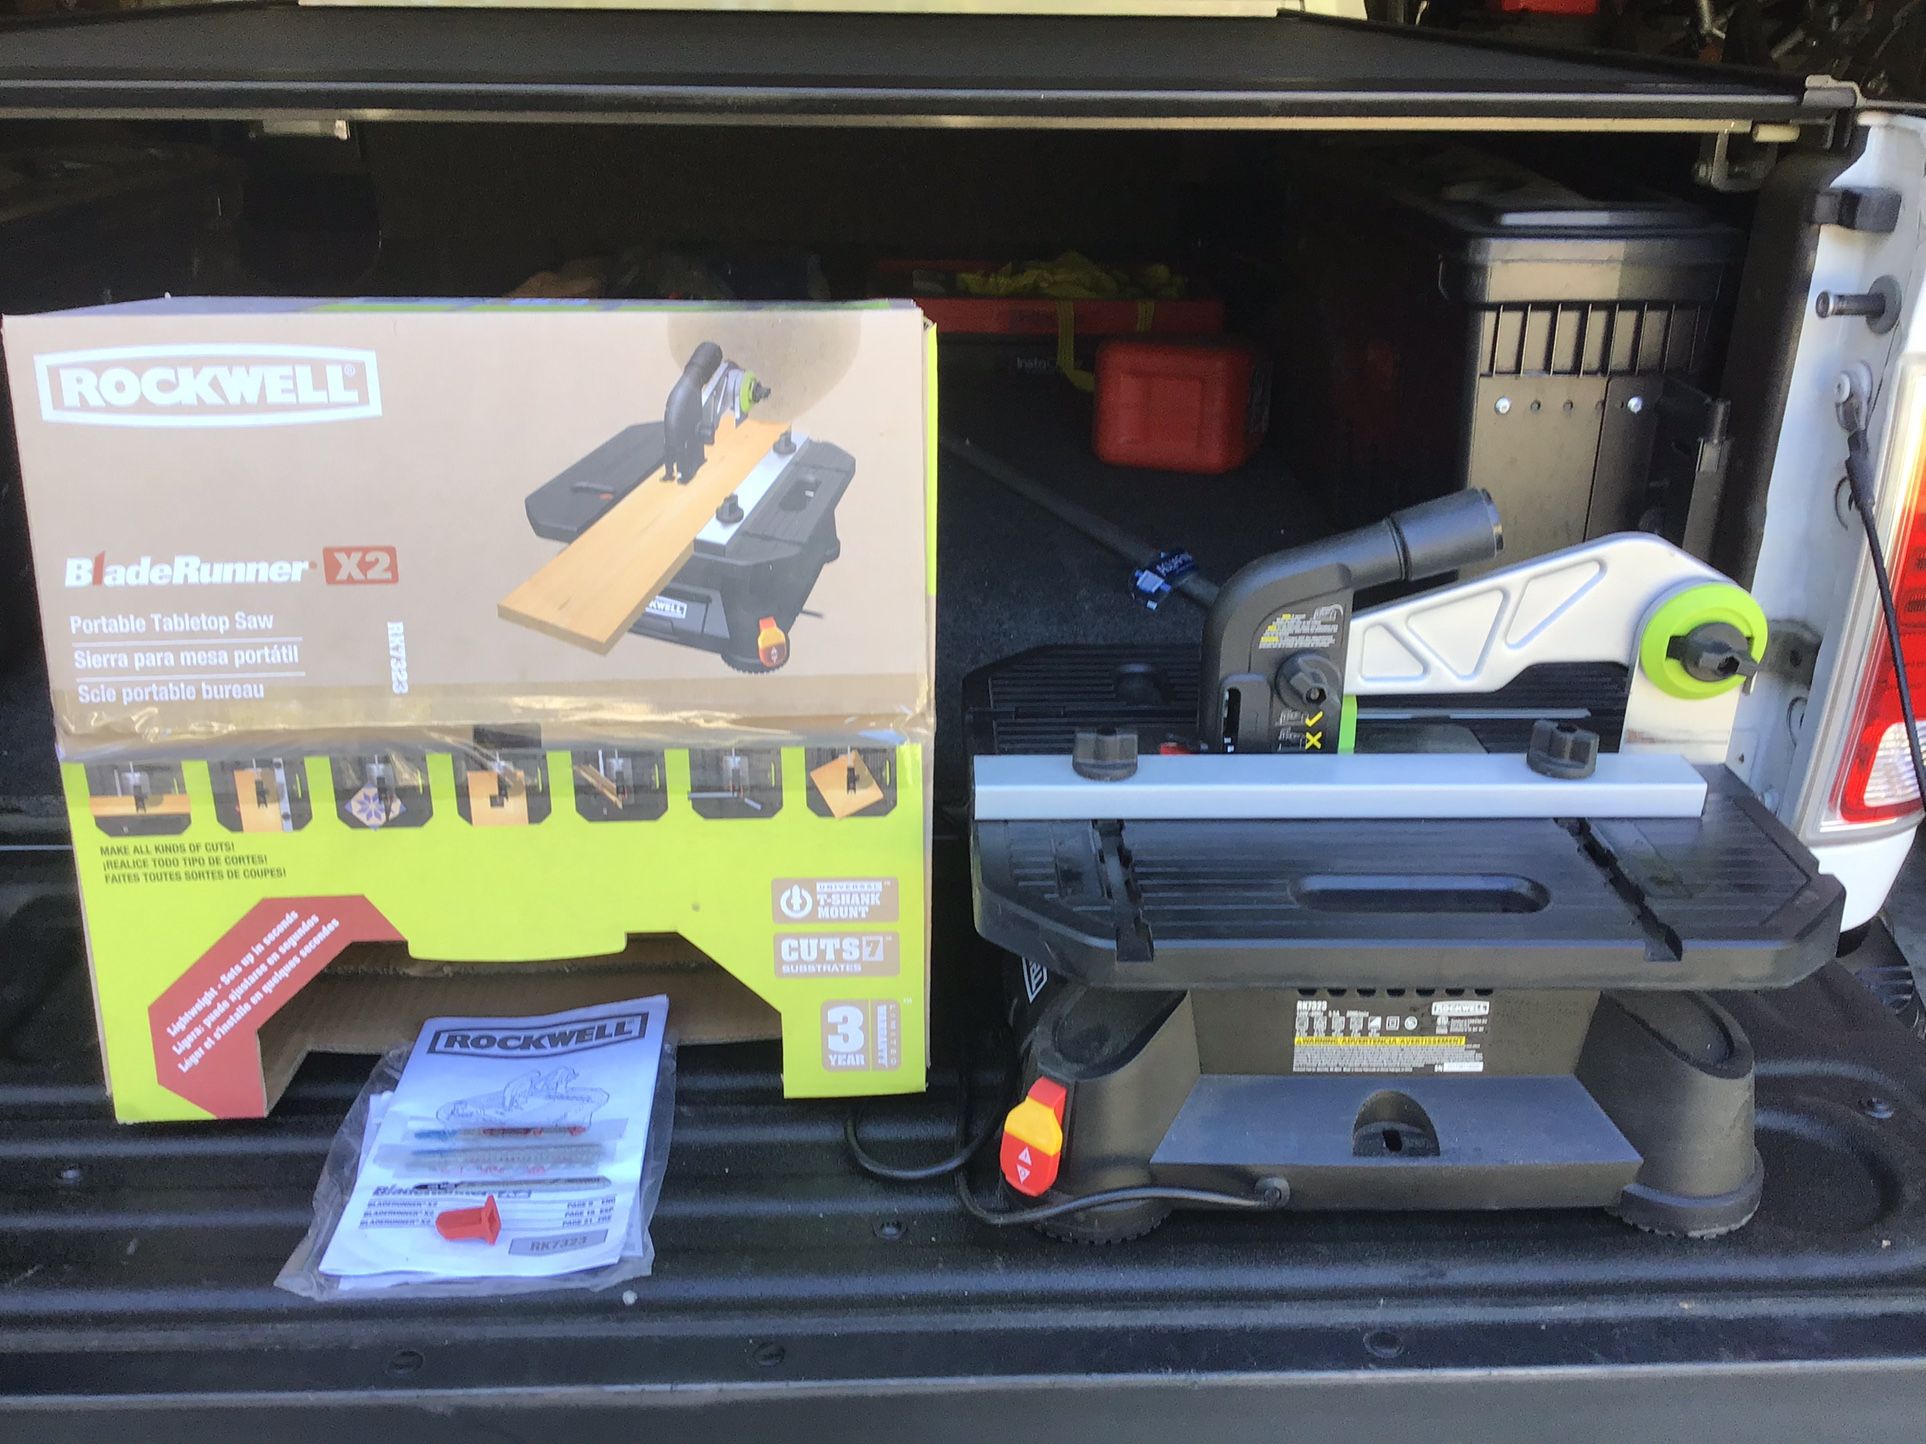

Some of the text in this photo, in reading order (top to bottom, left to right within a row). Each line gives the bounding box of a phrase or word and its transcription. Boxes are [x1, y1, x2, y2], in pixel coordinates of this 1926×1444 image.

[65, 551, 393, 588] BladeRunner X2
[70, 611, 274, 634] Portable Tabletop Saw
[74, 644, 299, 671] Sierra para mesa portátil
[78, 681, 264, 705] Scie portable bureau
[100, 841, 235, 857] MAKE ALL KINDS OF CUTS!
[152, 856, 179, 869] TODO
[182, 855, 206, 868] TIPO
[208, 855, 221, 867] DE
[224, 854, 268, 866] CORTES!
[105, 867, 287, 885] FAITES TOUTES SORTES DE COUPES!
[817, 893, 880, 906] T-SHANK
[818, 906, 869, 919] MOUNT
[781, 937, 860, 962] CUTS
[166, 910, 299, 1038] Lightweight Sets up in seconds
[203, 999, 230, 1029] puede
[228, 962, 268, 1002] ajustarse
[266, 951, 280, 966] en
[278, 913, 320, 954] segundos
[782, 963, 862, 974] SUBSTRATES
[203, 1036, 216, 1050] et
[250, 990, 264, 1005] en
[261, 955, 301, 994] quelques
[299, 917, 340, 958] secondes
[444, 1020, 633, 1050] ROCKWELL
[827, 1005, 864, 1053] 3
[829, 1053, 865, 1066] YEAR
